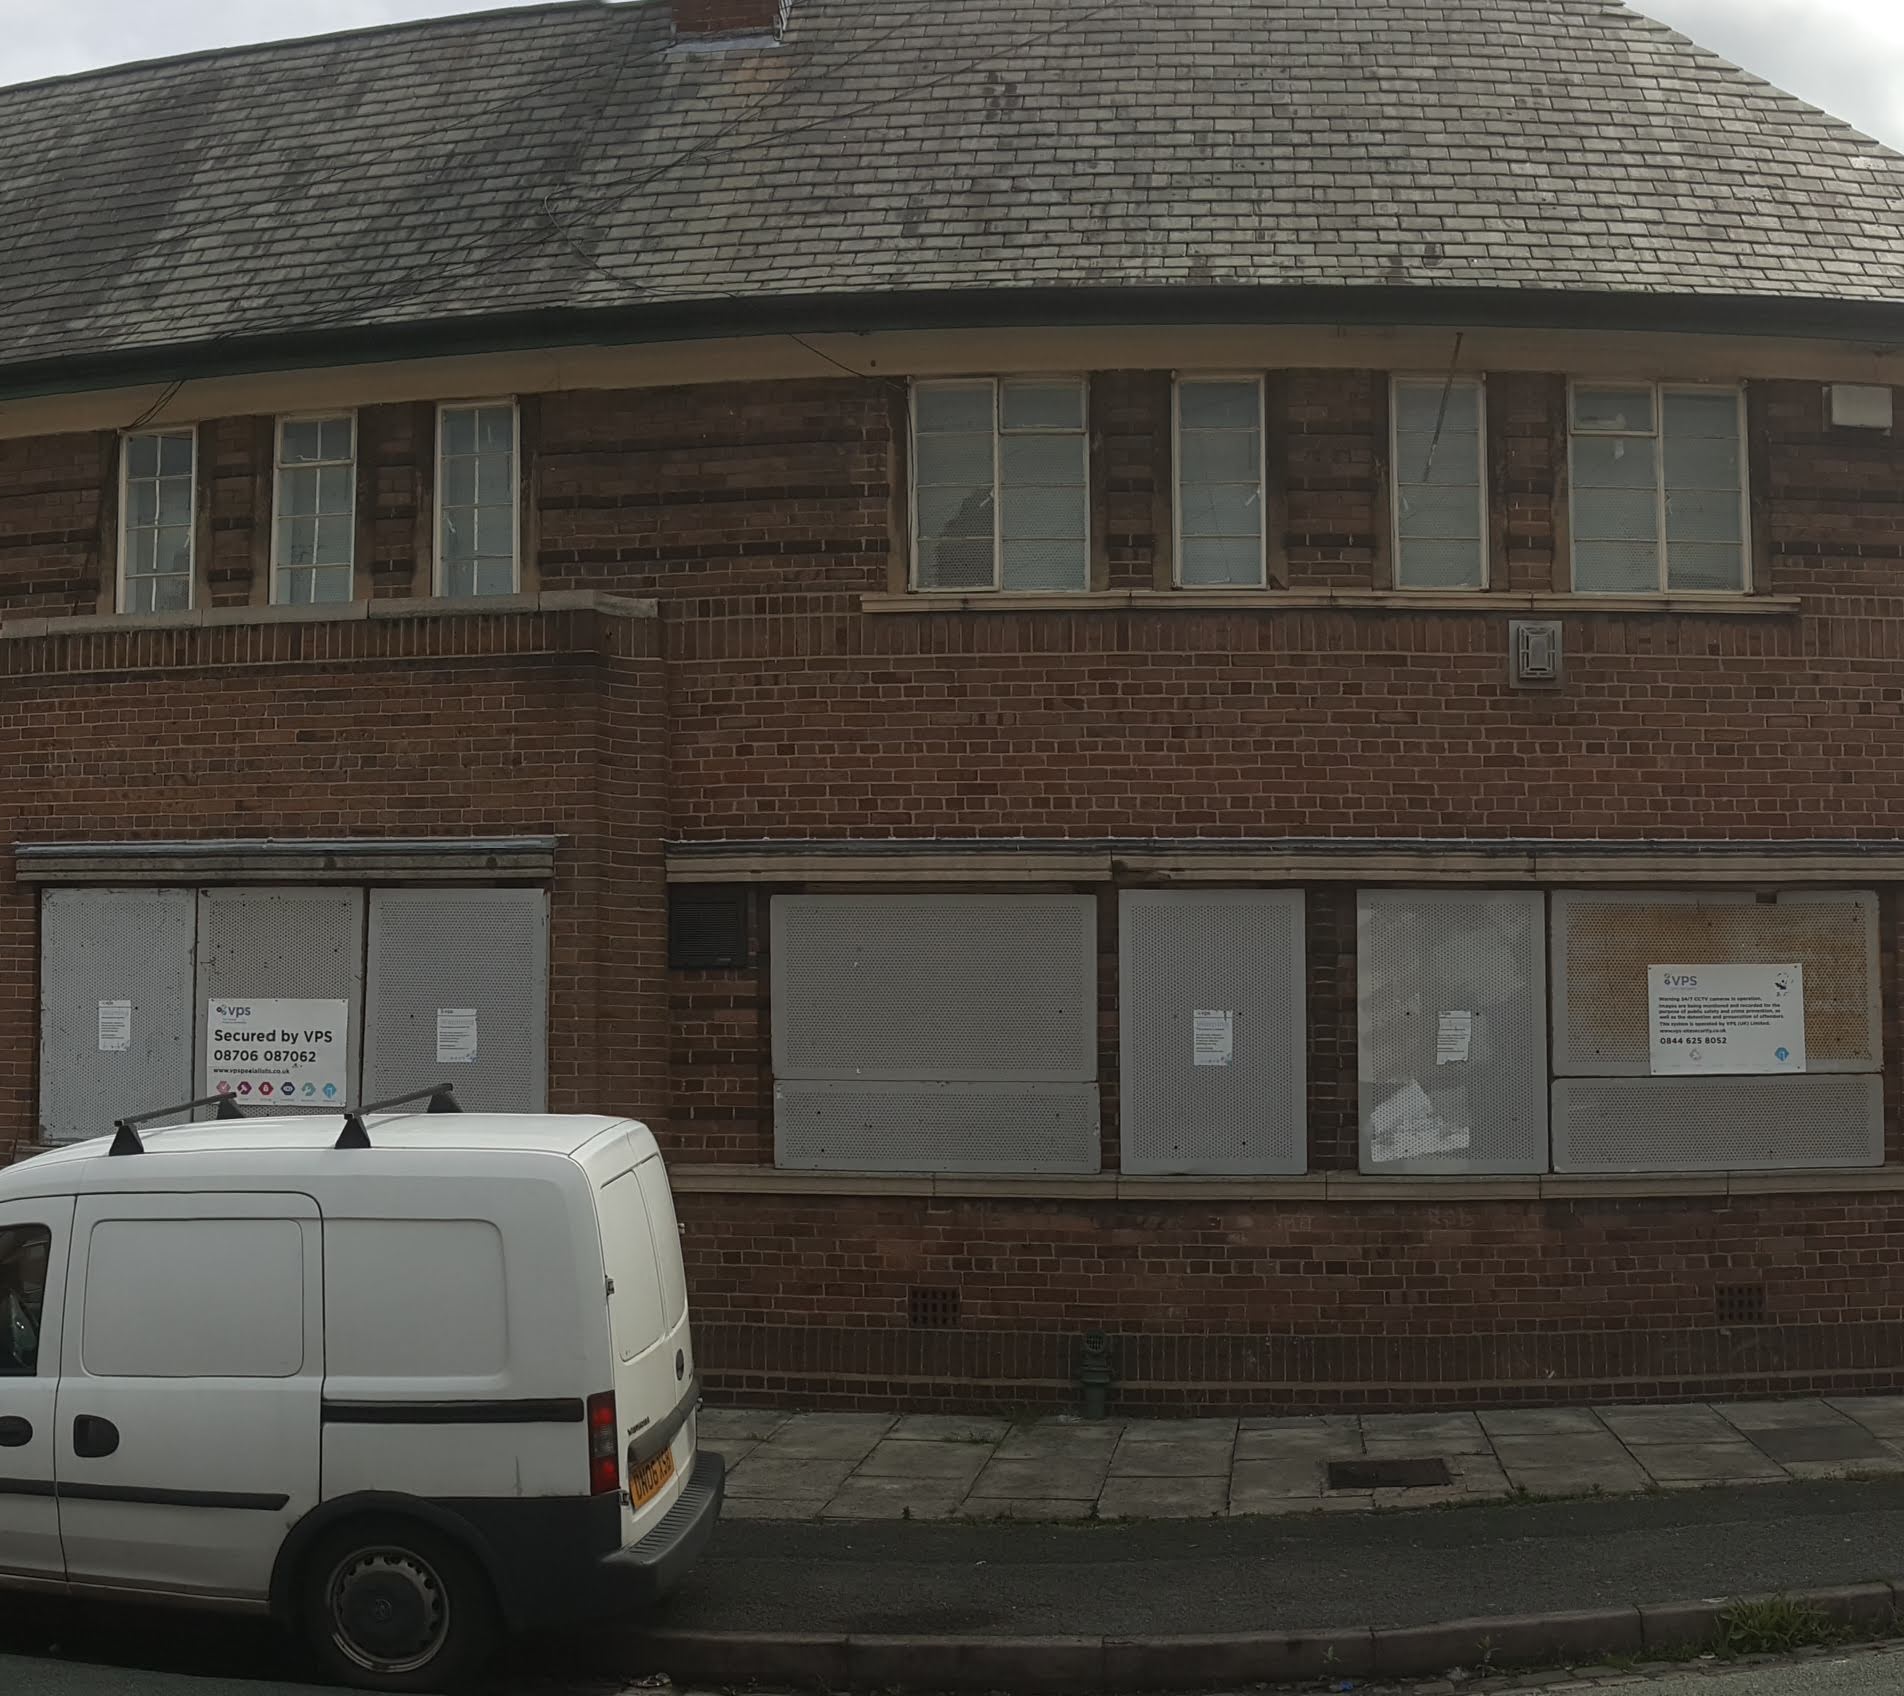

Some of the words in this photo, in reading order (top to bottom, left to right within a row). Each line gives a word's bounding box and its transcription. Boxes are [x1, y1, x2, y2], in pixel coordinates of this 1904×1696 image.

[228, 1007, 251, 1018] vps
[214, 1030, 276, 1042] Secured
[281, 1030, 299, 1044] by
[304, 1031, 333, 1043] VPS
[214, 1050, 258, 1061] 08706
[264, 1050, 316, 1062] 087062
